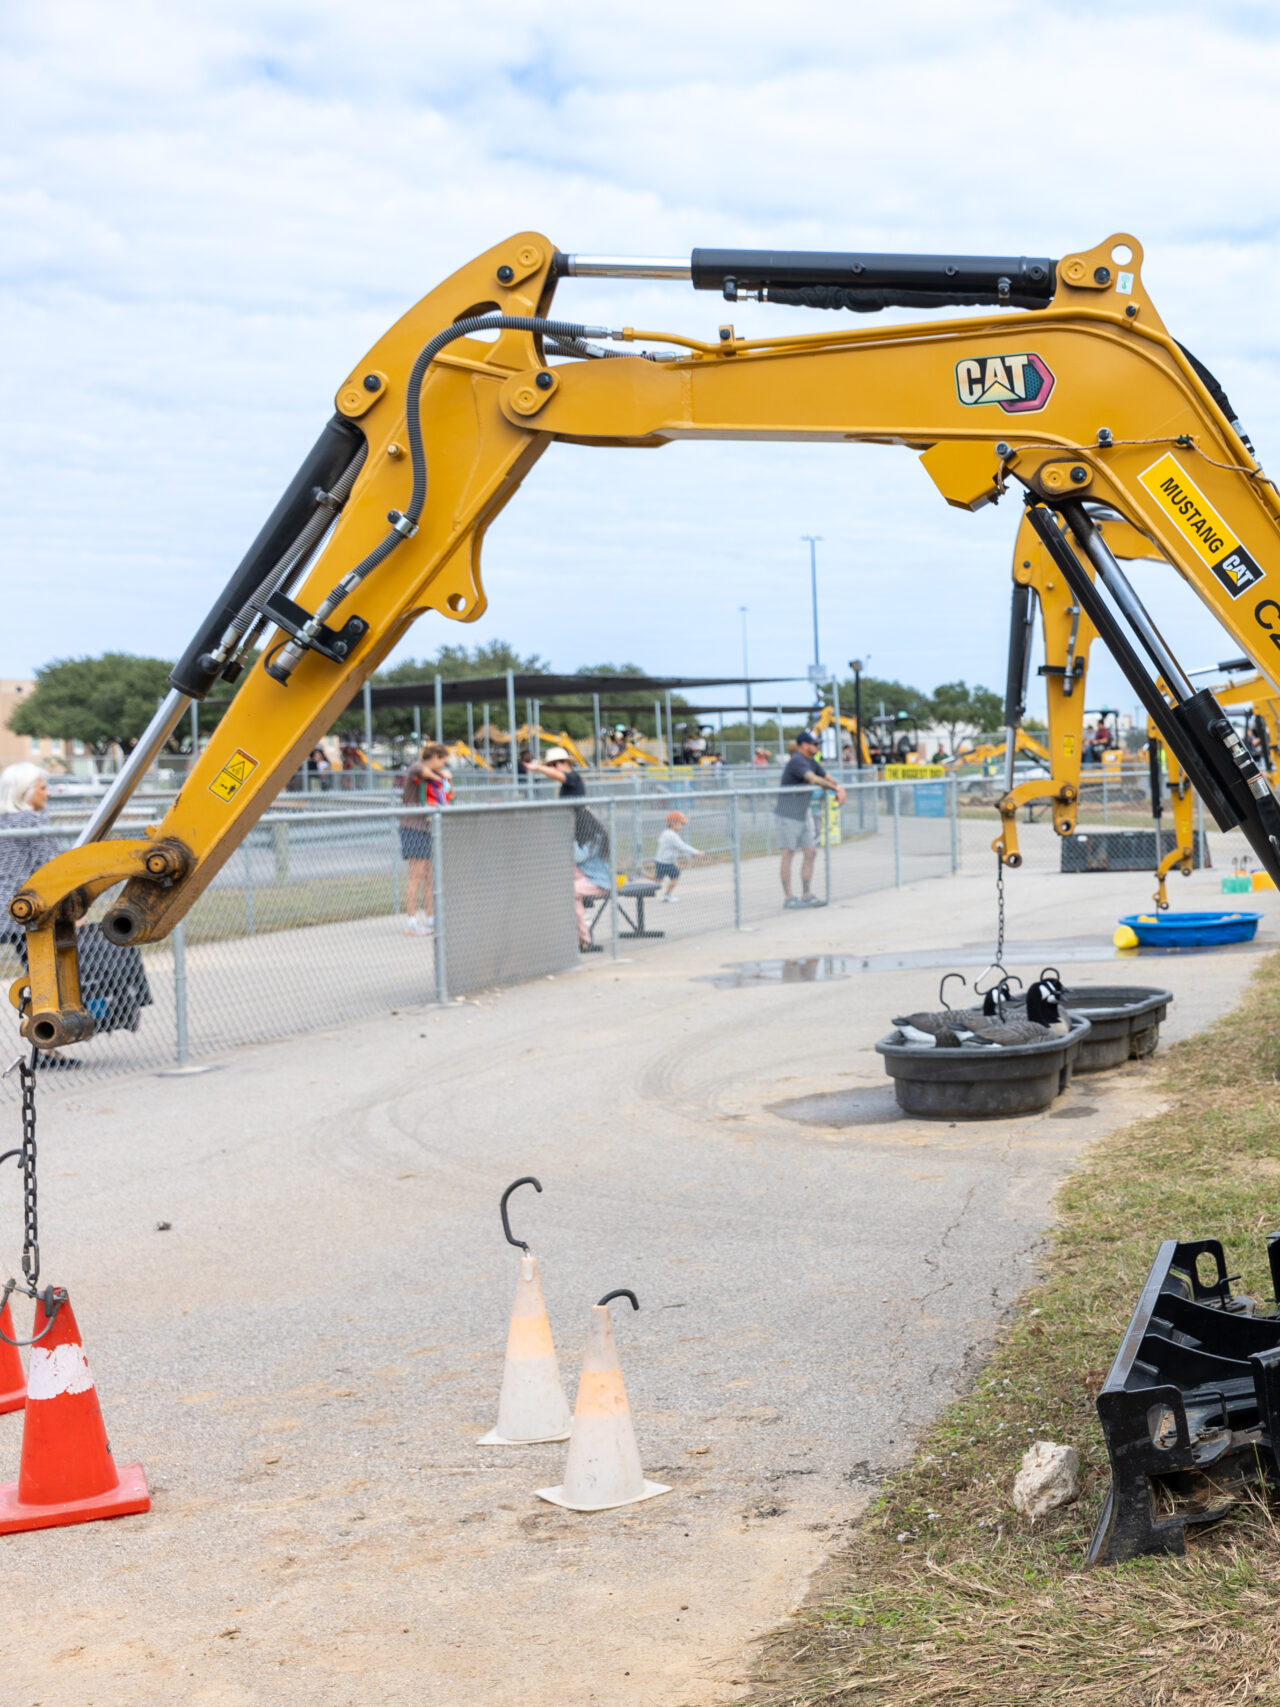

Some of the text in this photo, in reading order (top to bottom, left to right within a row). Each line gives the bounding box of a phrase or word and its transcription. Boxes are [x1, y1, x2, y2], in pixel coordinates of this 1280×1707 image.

[957, 355, 1028, 404] CAT
[1160, 477, 1254, 587] MUSTANG CAT
